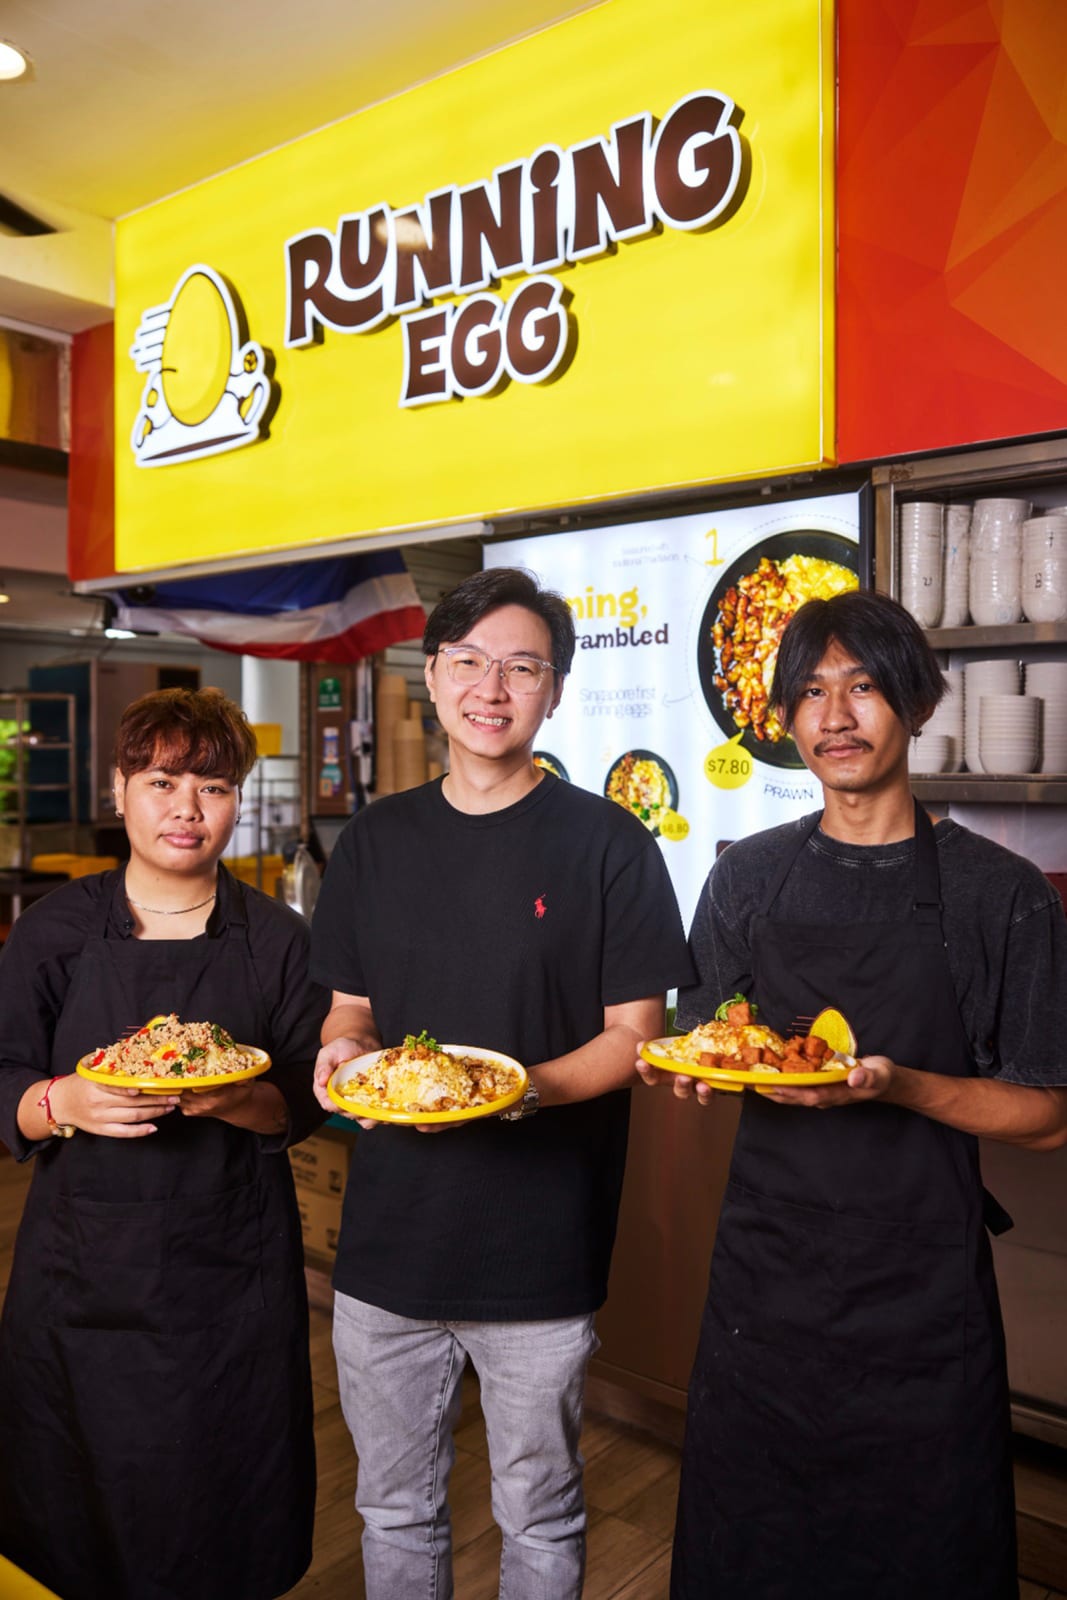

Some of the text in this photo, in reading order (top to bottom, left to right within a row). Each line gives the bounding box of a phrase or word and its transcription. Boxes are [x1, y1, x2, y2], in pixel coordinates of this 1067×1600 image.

[399, 273, 569, 407] EGG
[704, 528, 726, 567] 1
[707, 758, 750, 775] $7.80
[763, 783, 814, 800] PRAWN
